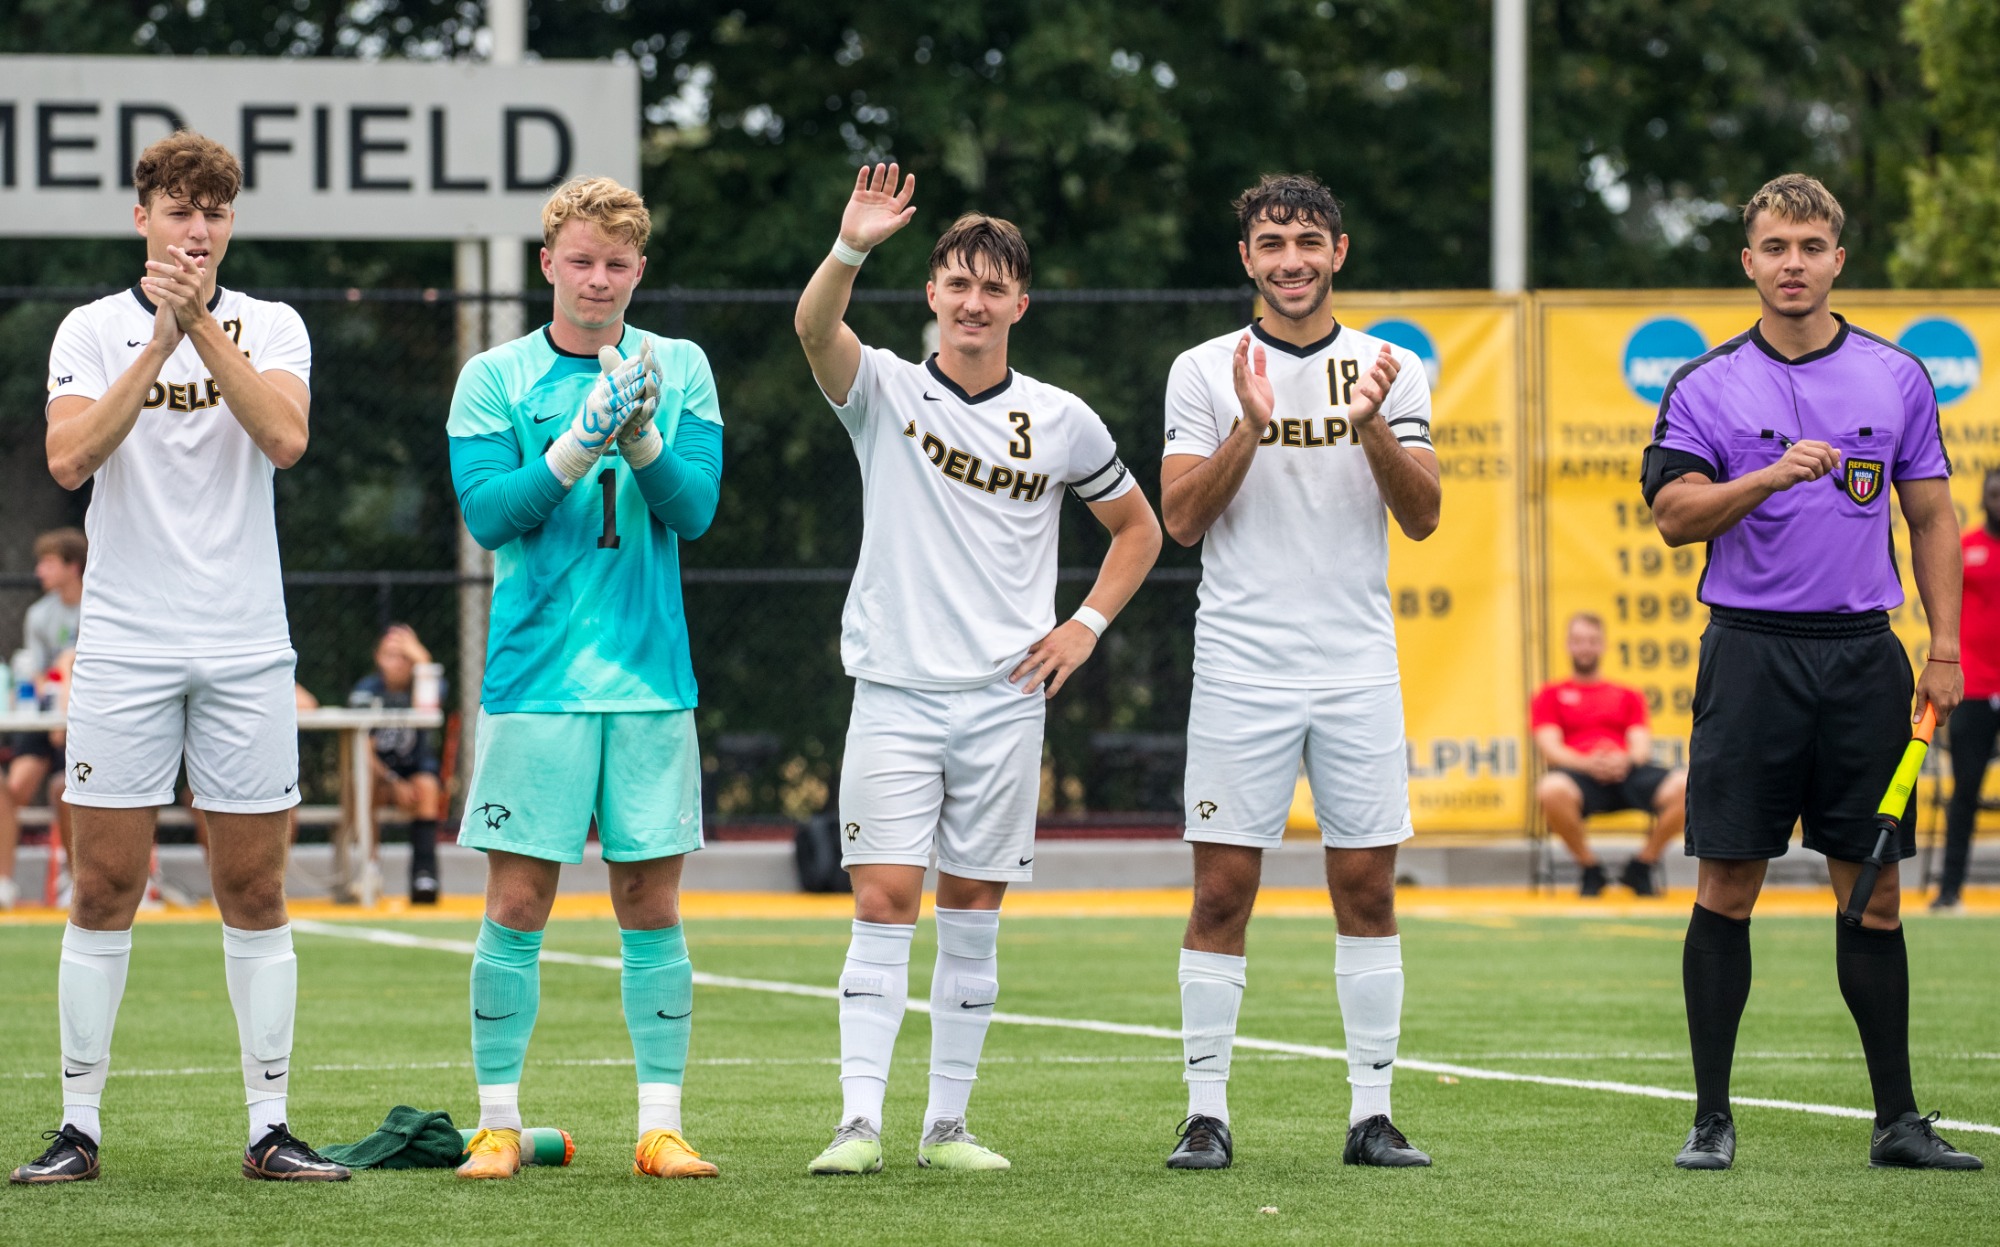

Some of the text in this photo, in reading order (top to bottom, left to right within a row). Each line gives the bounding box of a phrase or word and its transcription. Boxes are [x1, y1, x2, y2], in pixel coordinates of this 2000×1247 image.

[0, 103, 575, 192] ED FIELD
[142, 376, 222, 413] DELP
[1326, 358, 1359, 406] 18
[1009, 411, 1031, 459] 3
[1229, 415, 1361, 448] DELP
[903, 419, 1049, 502] ADELPHI
[1848, 460, 1881, 473] REFEREE
[597, 468, 621, 549] 1
[1617, 548, 1695, 577] 199
[1398, 586, 1454, 619] 89
[1616, 593, 1692, 623] 199
[1618, 640, 1690, 670] 199
[1408, 738, 1519, 779] LPHI
